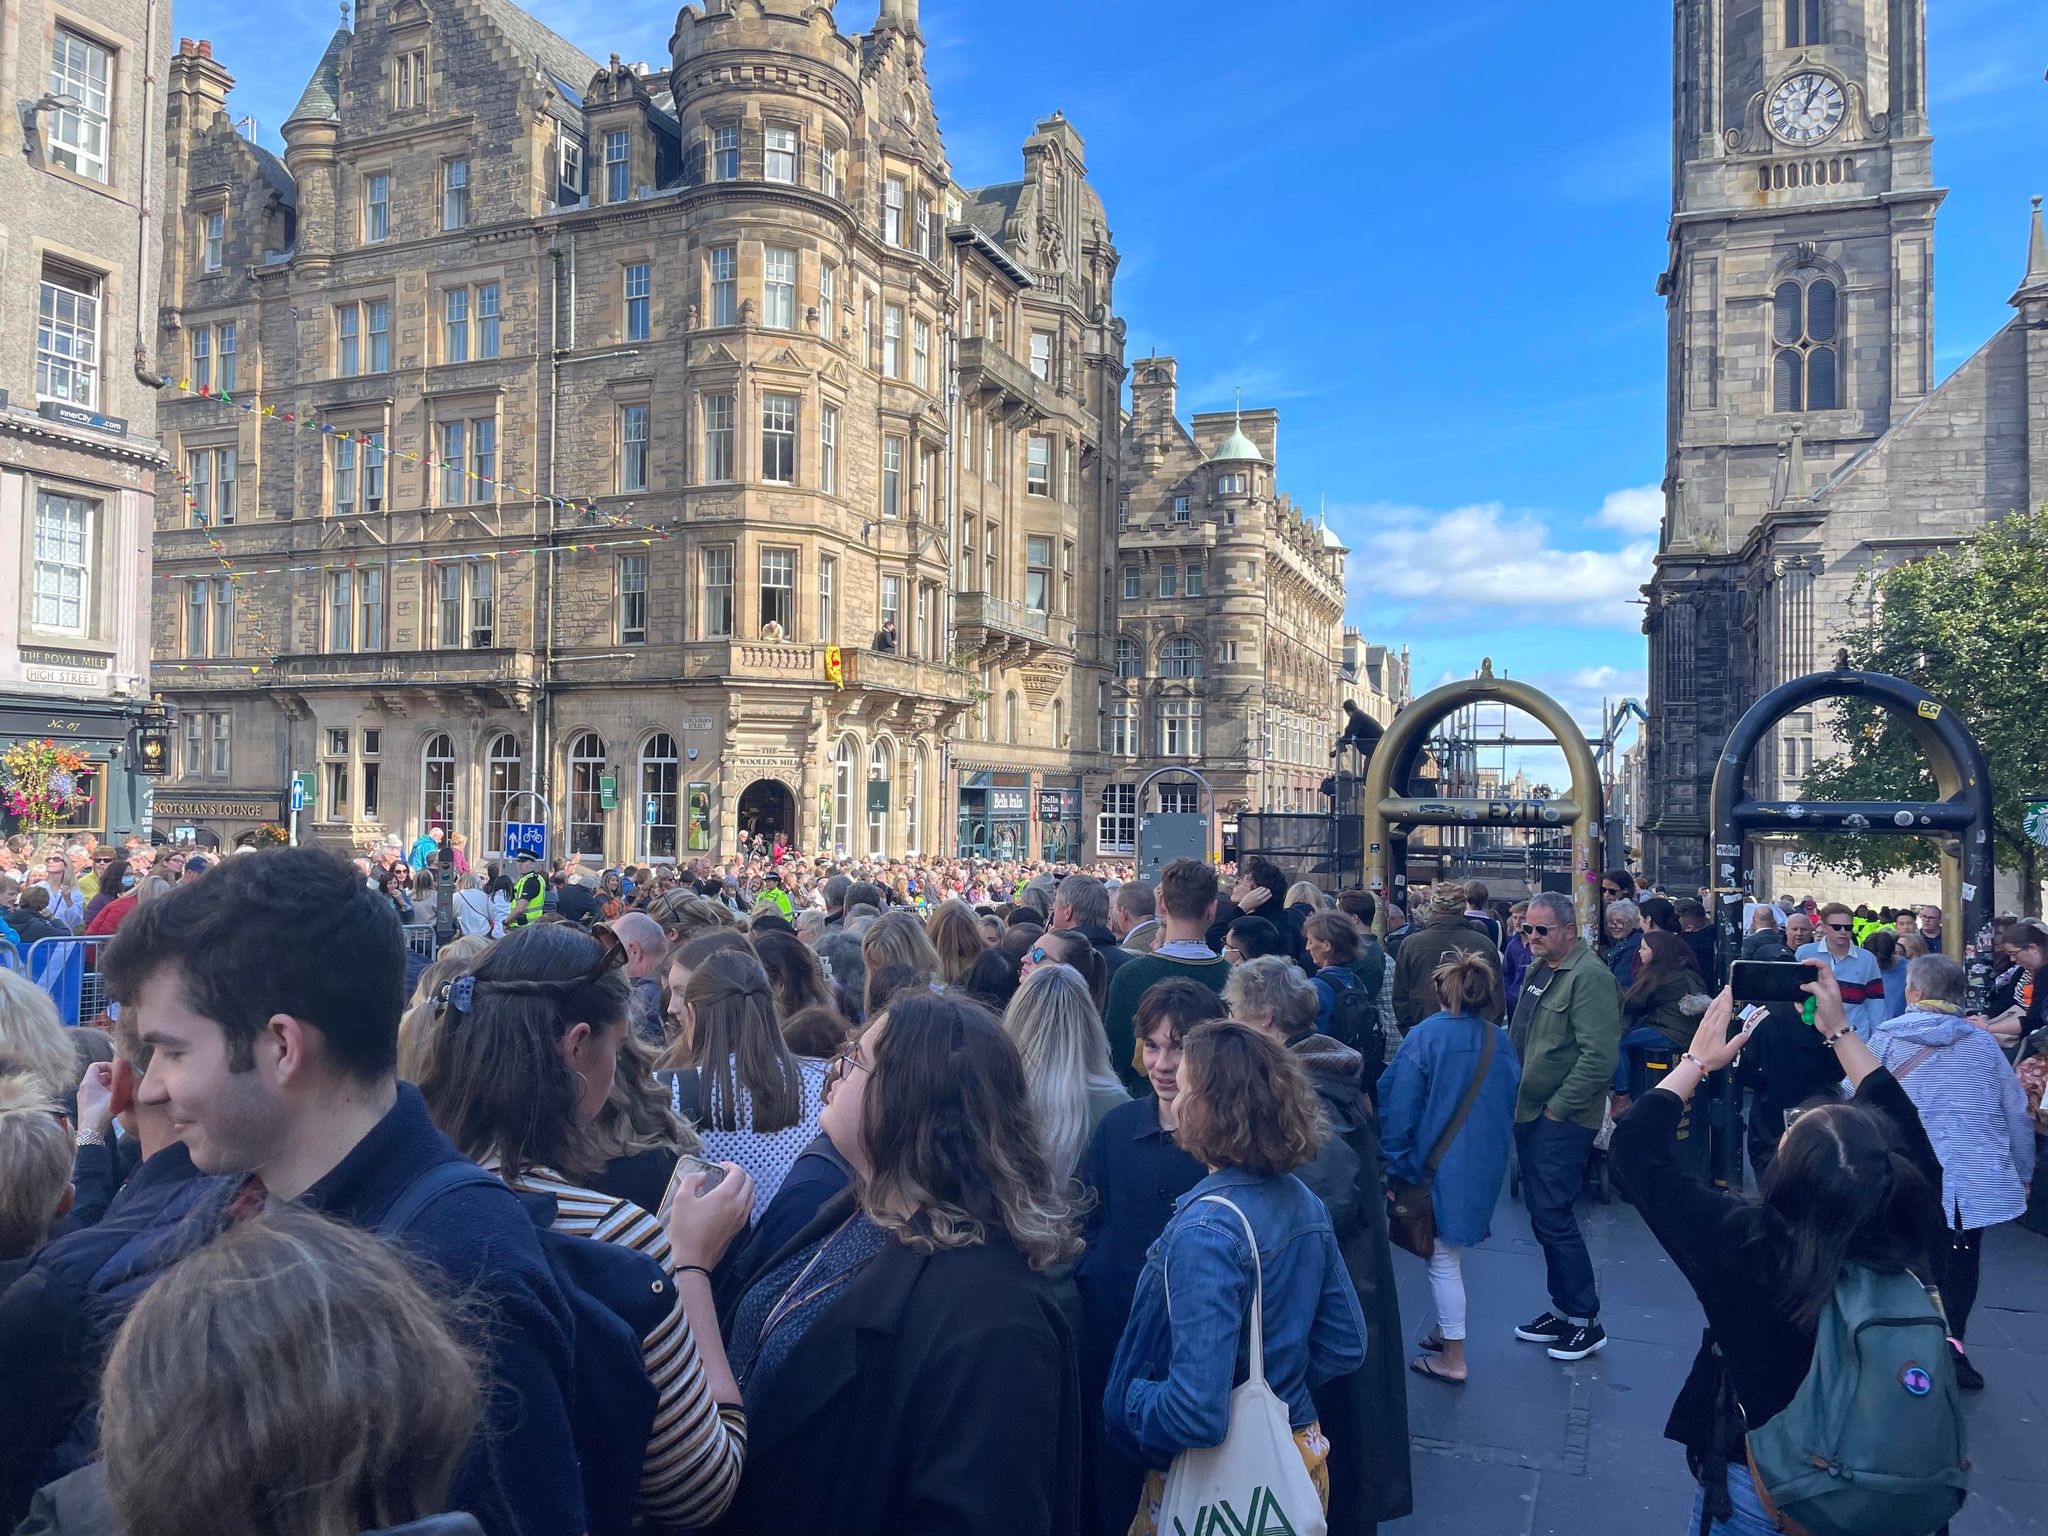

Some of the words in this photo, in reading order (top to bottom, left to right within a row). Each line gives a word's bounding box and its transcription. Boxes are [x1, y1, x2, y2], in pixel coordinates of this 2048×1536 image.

[22, 651, 41, 661] THE
[44, 653, 78, 666] ROYAL
[82, 656, 106, 668] MILE
[30, 670, 54, 681] HIGH
[60, 672, 97, 684] STREET
[740, 758, 777, 766] WOOLLEN
[993, 793, 1008, 808] Bella
[1009, 793, 1023, 808] Italia
[1041, 795, 1059, 804] Bella
[153, 802, 216, 815] SCOTSMAN'S
[219, 804, 263, 817] LOUNGE
[1041, 804, 1059, 813] Italia
[1488, 802, 1545, 820] EXIT
